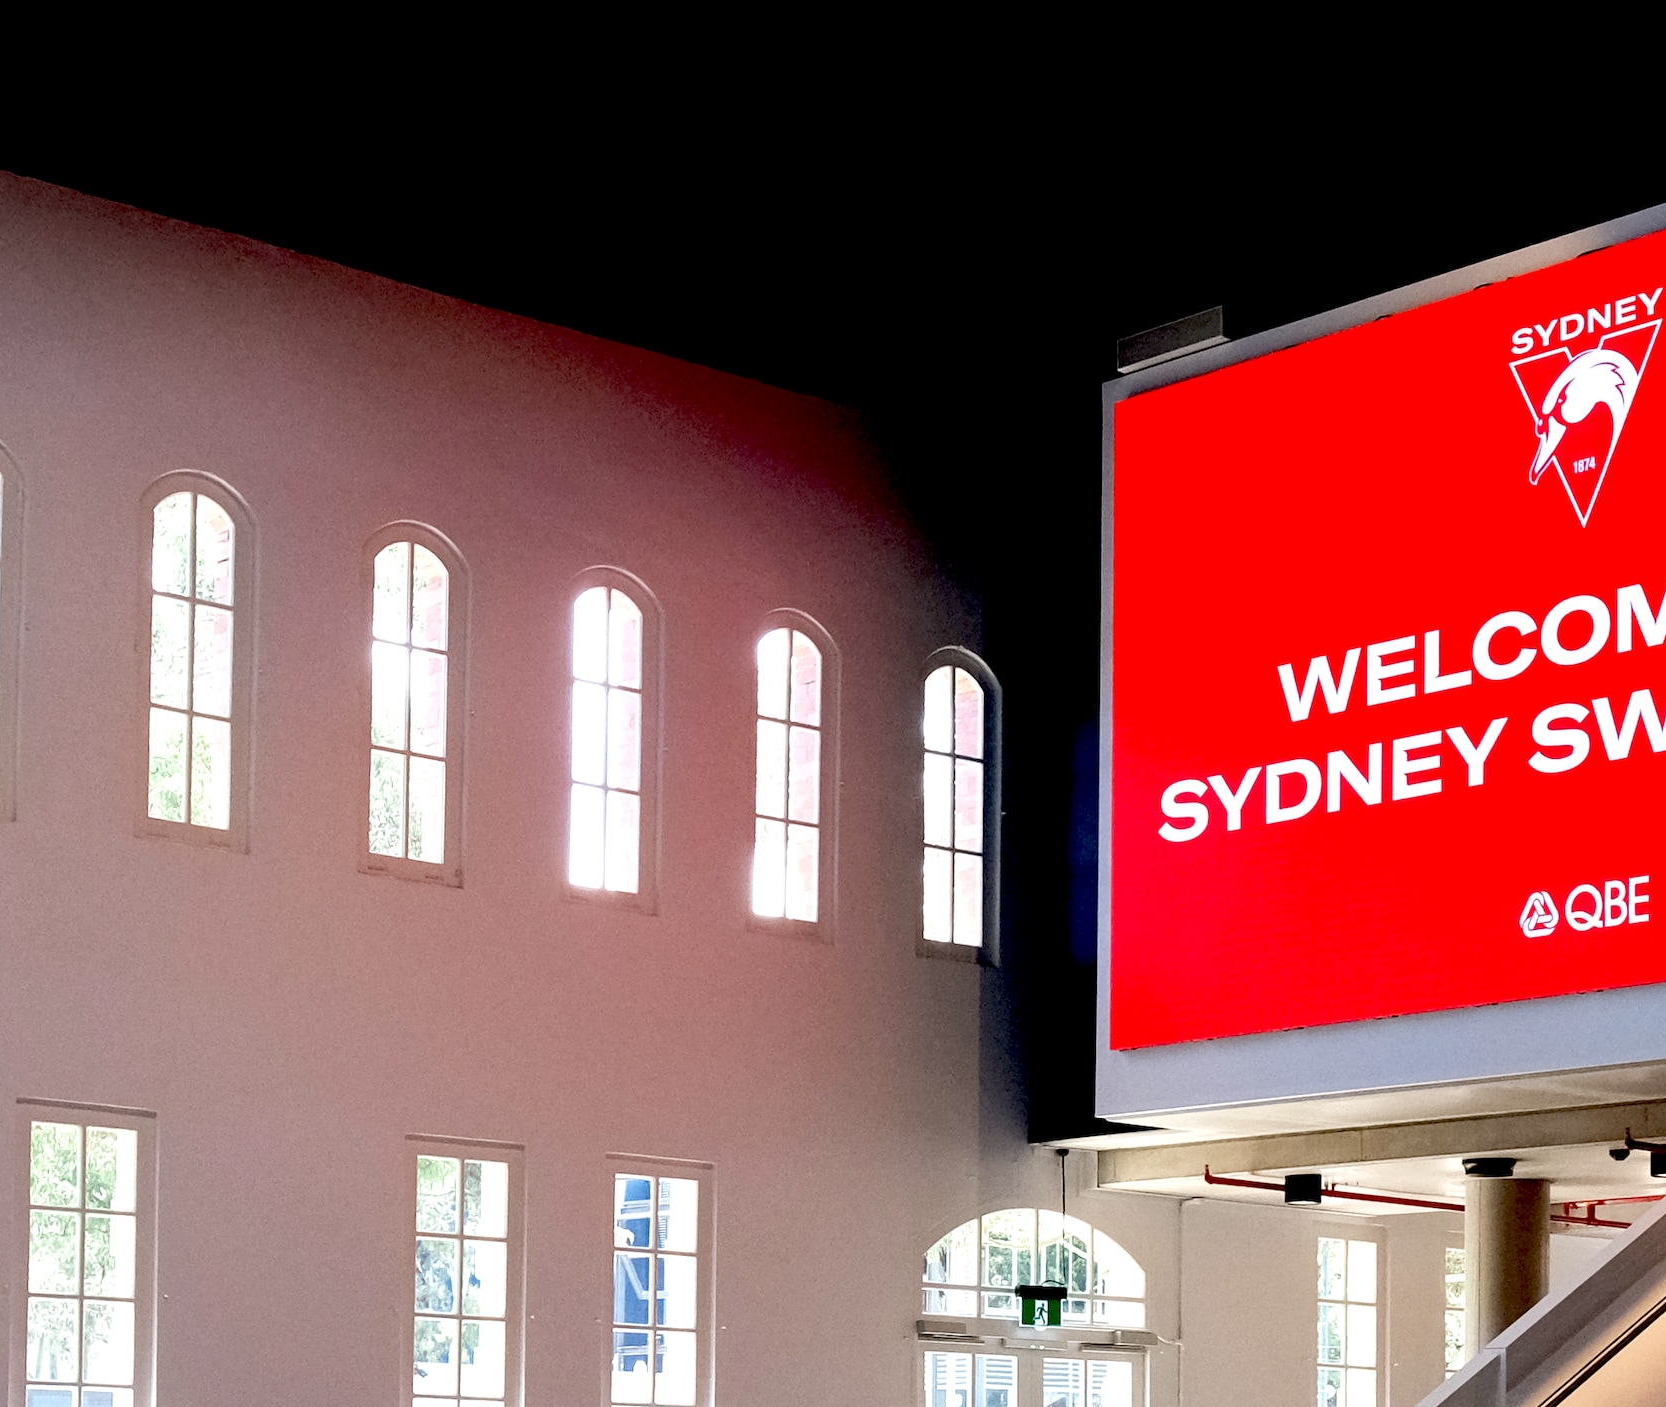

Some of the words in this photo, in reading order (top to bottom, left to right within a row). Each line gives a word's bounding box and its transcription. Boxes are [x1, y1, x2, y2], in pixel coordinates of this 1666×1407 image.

[1510, 288, 1664, 355] SYDNEY
[1573, 456, 1596, 474] 1874
[1157, 716, 1509, 843] SYDNEY
[1564, 875, 1650, 931] QBE
